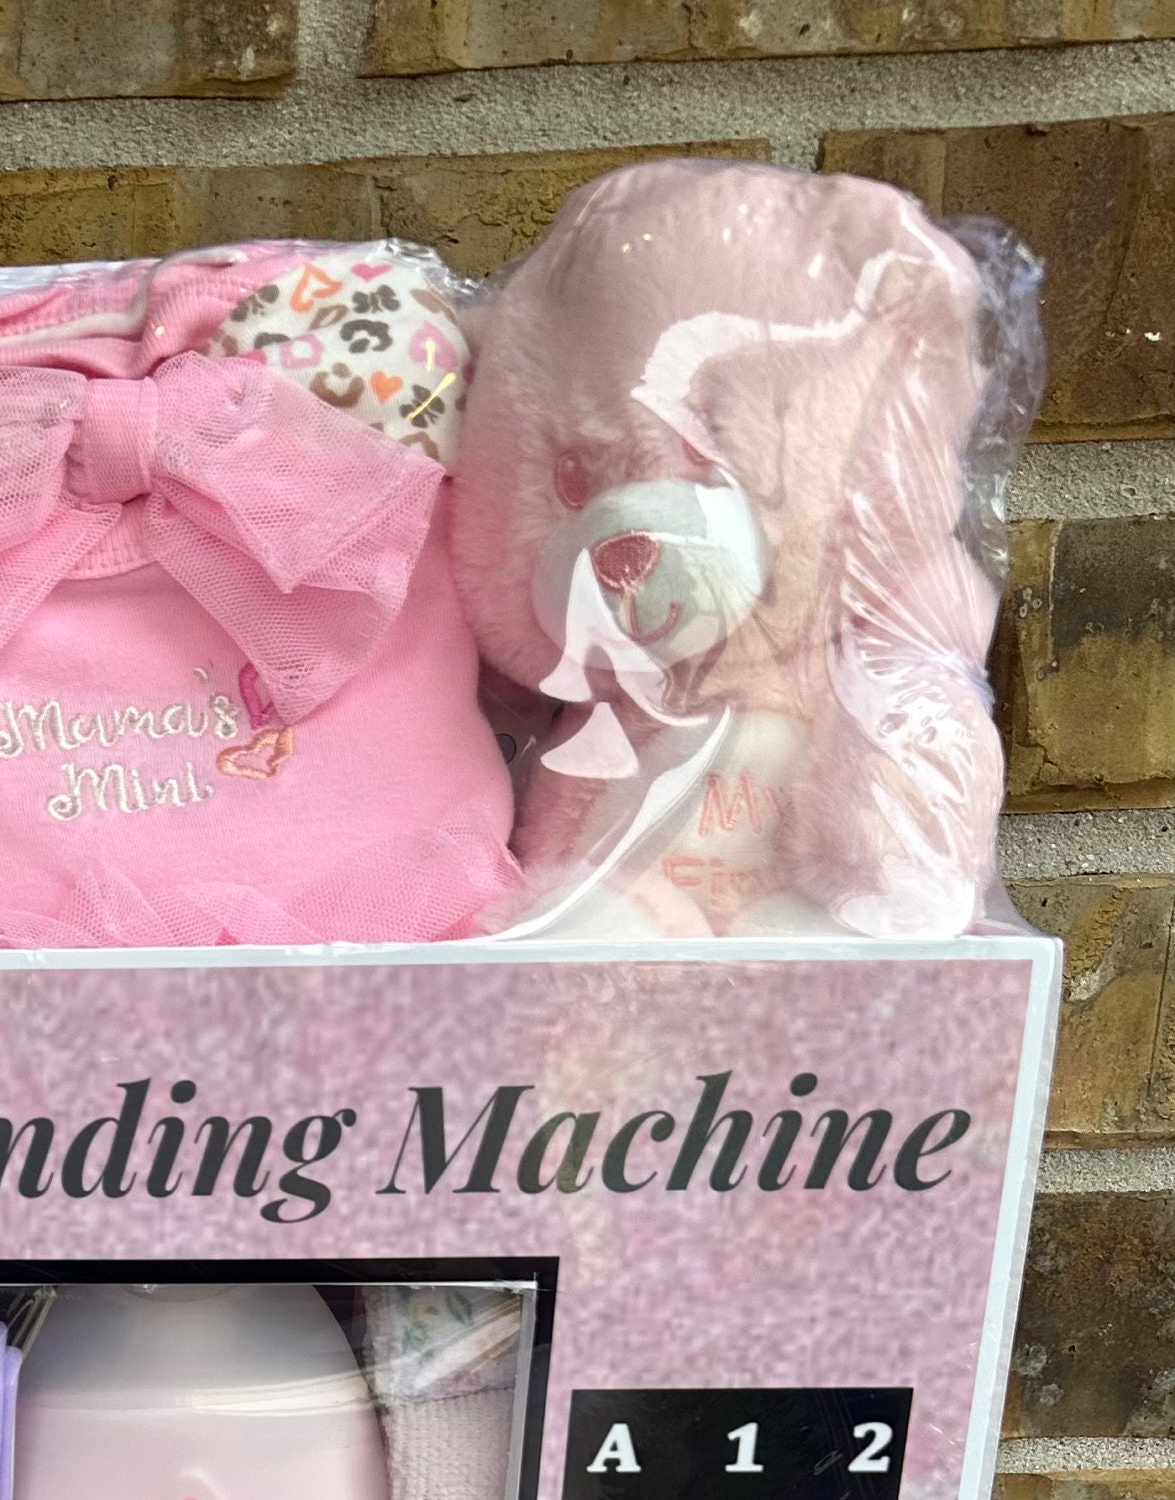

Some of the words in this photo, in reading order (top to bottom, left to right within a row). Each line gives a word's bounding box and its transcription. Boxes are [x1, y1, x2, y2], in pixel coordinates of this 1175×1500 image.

[375, 1071, 972, 1195] Machine
[586, 1422, 642, 1473] A
[725, 1422, 764, 1473] 1
[848, 1421, 894, 1473] 2
